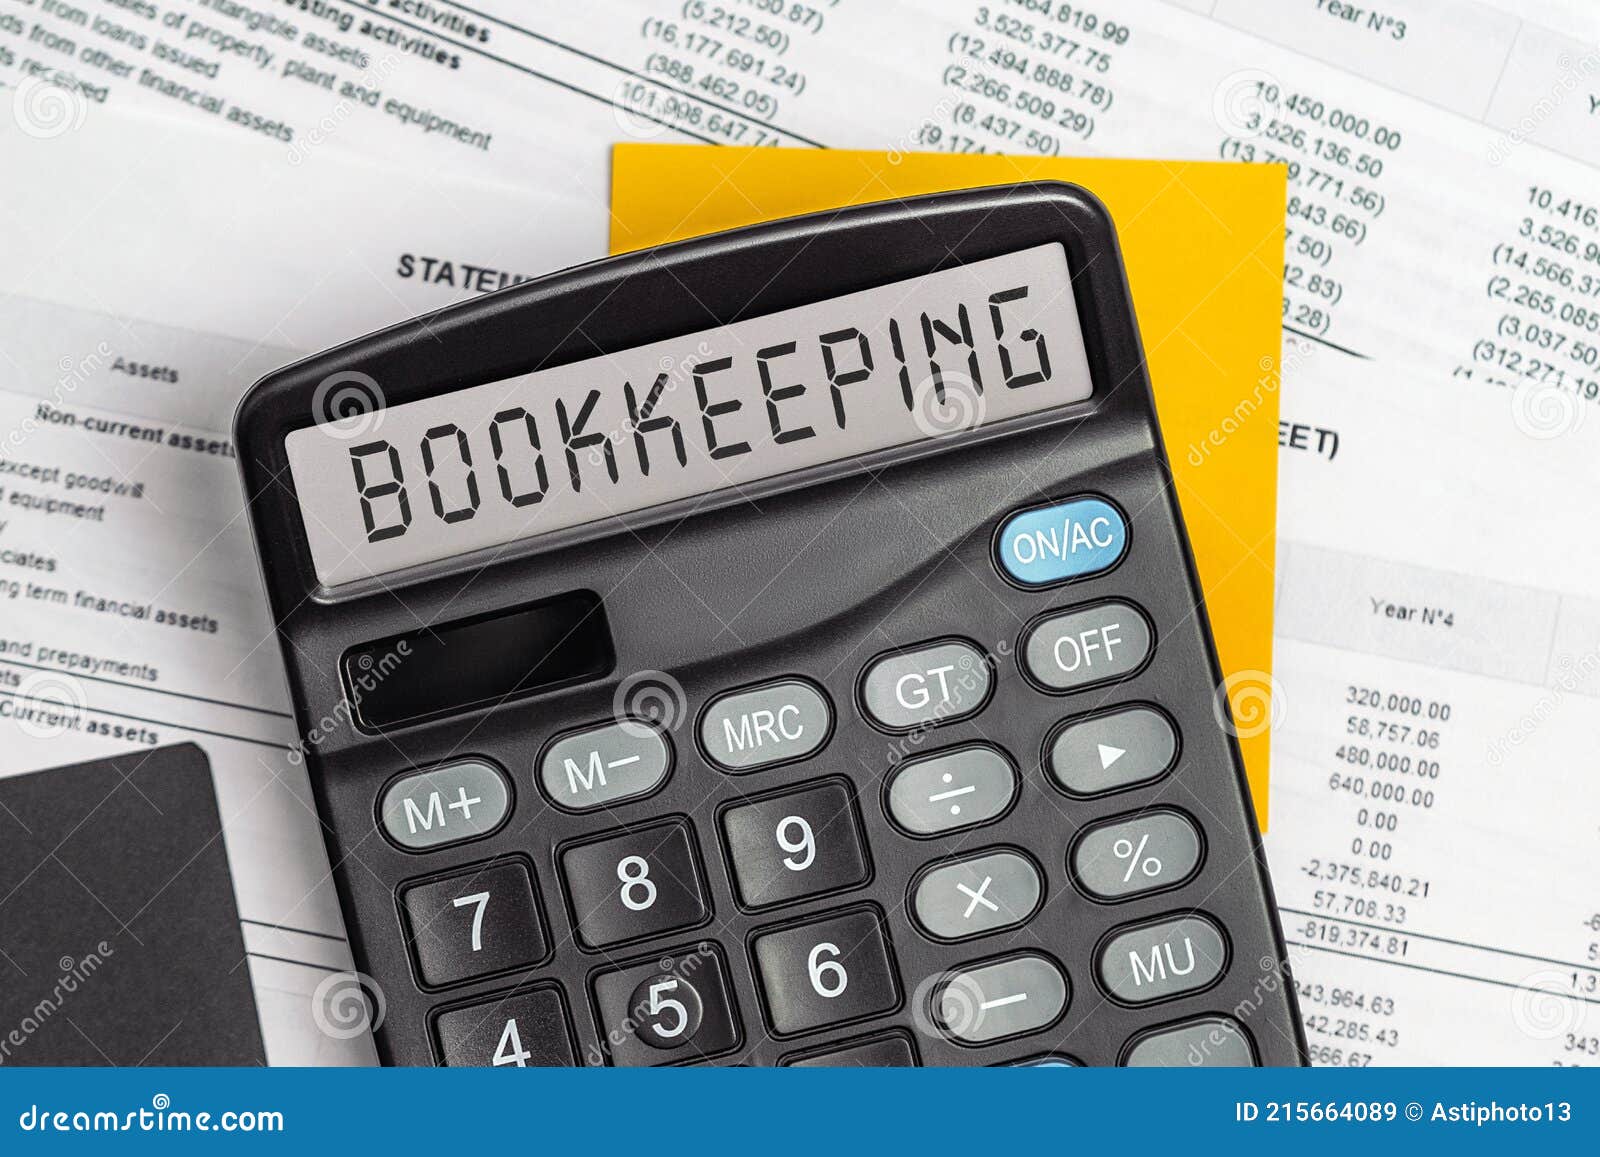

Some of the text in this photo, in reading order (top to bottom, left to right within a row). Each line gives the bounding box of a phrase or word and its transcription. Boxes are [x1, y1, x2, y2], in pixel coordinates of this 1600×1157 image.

[360, 20, 460, 70] activities
[28, 23, 76, 56] from
[226, 105, 294, 143] assets
[281, 58, 337, 92] plant
[383, 97, 492, 150] equipment
[110, 356, 180, 384] Assets
[34, 403, 164, 445] Non-current
[349, 285, 1052, 544] BOOKKEEPING
[9, 489, 105, 522] equipment
[1012, 516, 1114, 565] ON/AC
[26, 581, 69, 605] term
[74, 590, 153, 620] financial
[155, 607, 219, 634] assets
[1369, 597, 1418, 623] Year
[37, 645, 159, 683] prepayments
[1053, 623, 1123, 673] OFF
[895, 664, 954, 710] GT
[1345, 685, 1452, 723] 320,000.00
[86, 717, 160, 746] assets
[722, 703, 804, 753] MRC
[1346, 716, 1440, 750] 58,757.06
[1335, 745, 1441, 781] 480,000.00
[403, 787, 482, 834] M+
[1328, 772, 1435, 810] 640,000.00
[775, 815, 817, 871] 9
[1356, 808, 1398, 832] 0.00
[1351, 838, 1393, 861] 0.00
[616, 855, 658, 911] 8
[1300, 859, 1431, 900] -2,375,840.21
[453, 891, 491, 951] 7
[1313, 890, 1408, 926] 57,708.33
[1128, 937, 1196, 987] MU
[1296, 921, 1410, 958] -819,374.81
[807, 942, 849, 998] 6
[649, 979, 689, 1038] 5
[491, 1018, 531, 1067] 4
